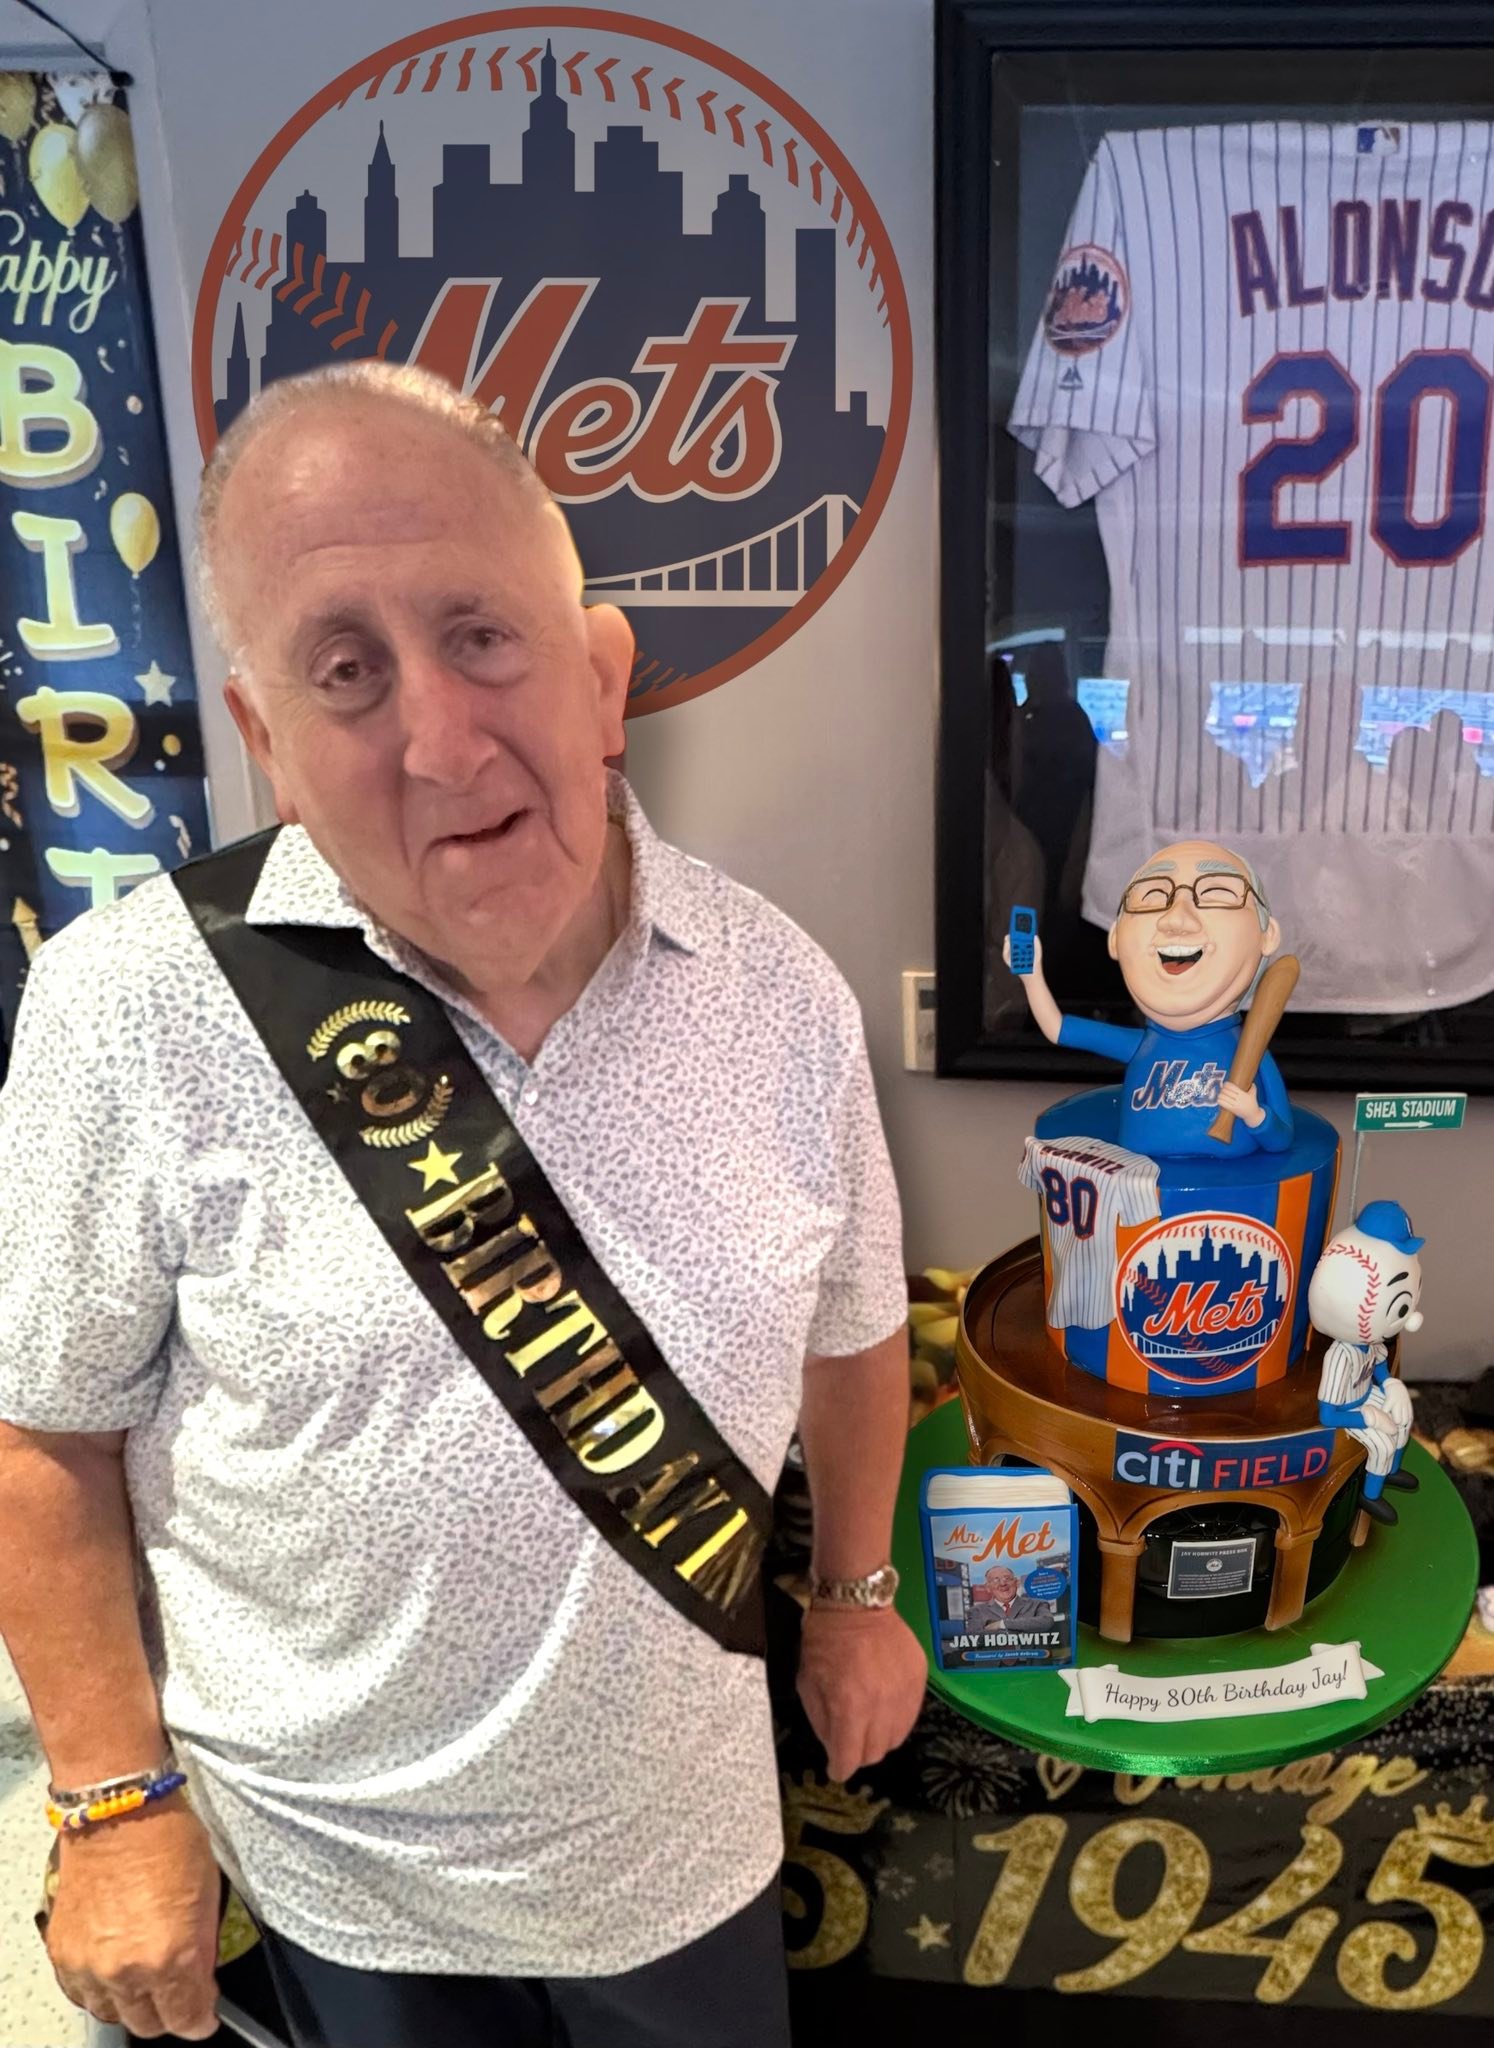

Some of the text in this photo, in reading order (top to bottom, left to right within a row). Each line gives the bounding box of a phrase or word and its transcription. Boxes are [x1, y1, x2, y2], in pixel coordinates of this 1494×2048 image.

[0, 210, 118, 334] appy
[1237, 348, 1494, 569] 20
[1365, 1100, 1457, 1118] SHEA STADIUM
[1041, 1166, 1099, 1240] 80
[1143, 1279, 1267, 1336] Mets
[1213, 1447, 1328, 1488] FIELD
[944, 1514, 1056, 1562] Mr. Met
[950, 1632, 1061, 1649] JAY HORWITZ
[1105, 1660, 1347, 1712] Happy 80th Birthday Jay!
[963, 1796, 1494, 2011] 1945
